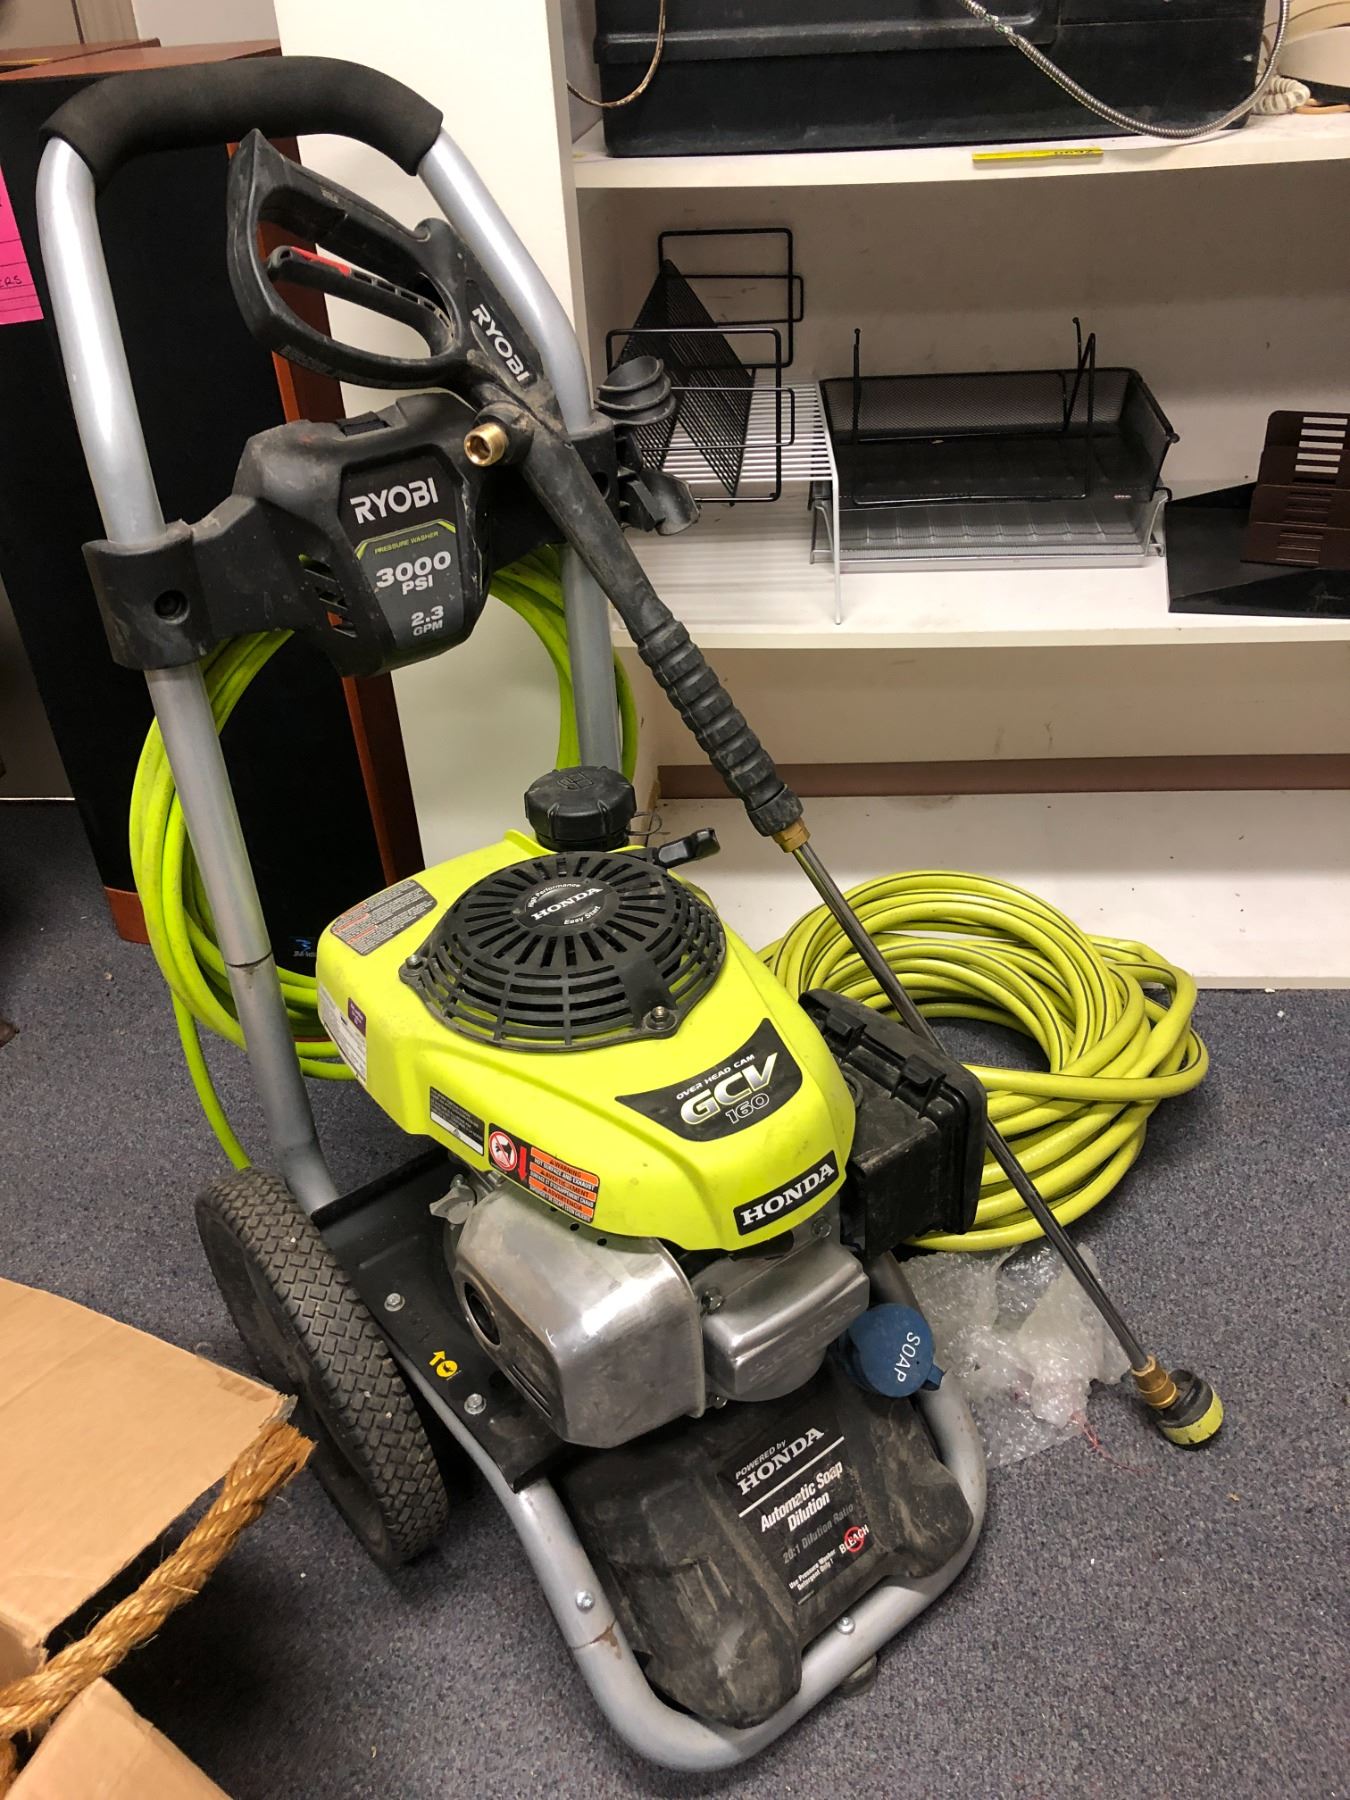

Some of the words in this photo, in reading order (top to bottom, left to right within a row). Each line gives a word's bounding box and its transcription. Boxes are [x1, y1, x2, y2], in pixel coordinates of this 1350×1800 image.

[472, 304, 530, 382] RYOBI
[350, 477, 439, 524] RYOBI
[374, 539, 410, 555] PRESSURE
[411, 531, 439, 544] WASHER
[376, 551, 451, 588] 3000
[402, 574, 434, 596] PSI
[411, 605, 444, 627] 2.3
[413, 620, 443, 637] GPM
[531, 888, 603, 920] HONDA
[536, 883, 581, 898] Performance
[563, 916, 584, 925] Easy
[584, 905, 601, 919] Start
[676, 1082, 703, 1100] OVER
[704, 1066, 731, 1085] HEAD
[733, 1054, 755, 1068] CAM
[681, 1052, 778, 1125] GCV
[725, 1093, 769, 1124] 160
[534, 1157, 543, 1166] HOT
[544, 1163, 562, 1177] SURFACE
[562, 1173, 573, 1181] AND
[573, 1178, 594, 1191] EXHAUST
[554, 1160, 582, 1178] WARNING
[547, 1188, 583, 1211] ADVERTENCIA
[740, 1163, 834, 1226] HONDA
[894, 1332, 921, 1382] SOAP
[735, 1447, 776, 1479] POWERED
[776, 1440, 786, 1450] by
[737, 1428, 824, 1495] HONDA
[761, 1482, 816, 1532] Automatic
[816, 1461, 843, 1489] Soap
[787, 1492, 830, 1532] Dilution
[783, 1544, 800, 1564] 20:1
[801, 1520, 832, 1549] Dilution
[833, 1504, 854, 1524] Ratio
[839, 1524, 870, 1554] BLEACH
[789, 1579, 799, 1589] Use
[798, 1562, 819, 1581] Pressure
[818, 1549, 836, 1564] Washer
[797, 1569, 821, 1590] Detergent
